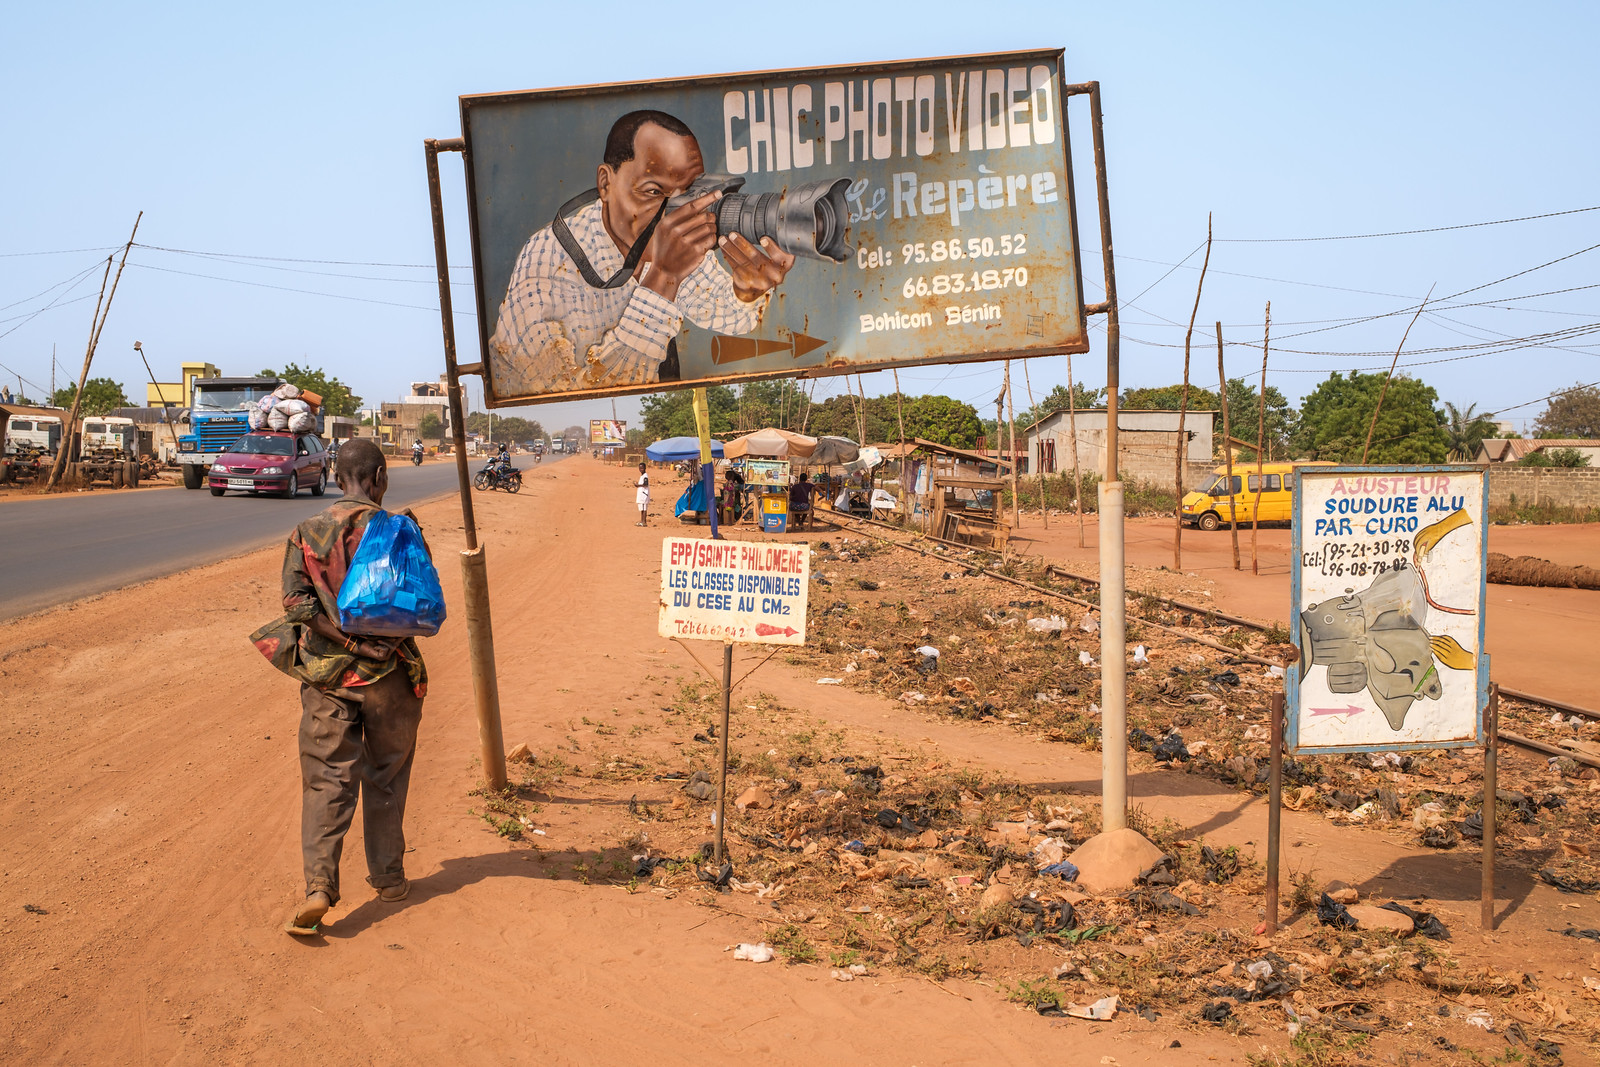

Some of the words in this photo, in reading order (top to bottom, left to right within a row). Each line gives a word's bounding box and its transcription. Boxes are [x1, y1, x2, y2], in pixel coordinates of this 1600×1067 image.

[724, 84, 814, 174] CHIC
[825, 75, 935, 165] PHOTO
[945, 65, 1055, 153] VIDEO
[844, 178, 888, 224] Le
[893, 164, 1058, 227] Repère
[857, 246, 892, 269] Cel:
[902, 234, 1027, 264] 95.86.50.52
[860, 311, 932, 333] Bohicon
[945, 303, 1001, 326] Bénin
[1331, 476, 1450, 495] AJUSTEUR
[1325, 496, 1418, 515] SOUDURE
[1426, 496, 1464, 511] ALU
[1315, 517, 1352, 536] PAR
[1366, 516, 1418, 535] CURO
[670, 541, 737, 569] EPP/SAINTE
[741, 546, 803, 574] PHILOMENE
[669, 570, 688, 588] LES
[691, 571, 734, 592] CLASSES
[737, 574, 800, 596] DISPONIBLES
[673, 591, 691, 607] DU
[697, 591, 731, 611] CESE
[737, 597, 754, 612] AU
[762, 598, 791, 615] CM2
